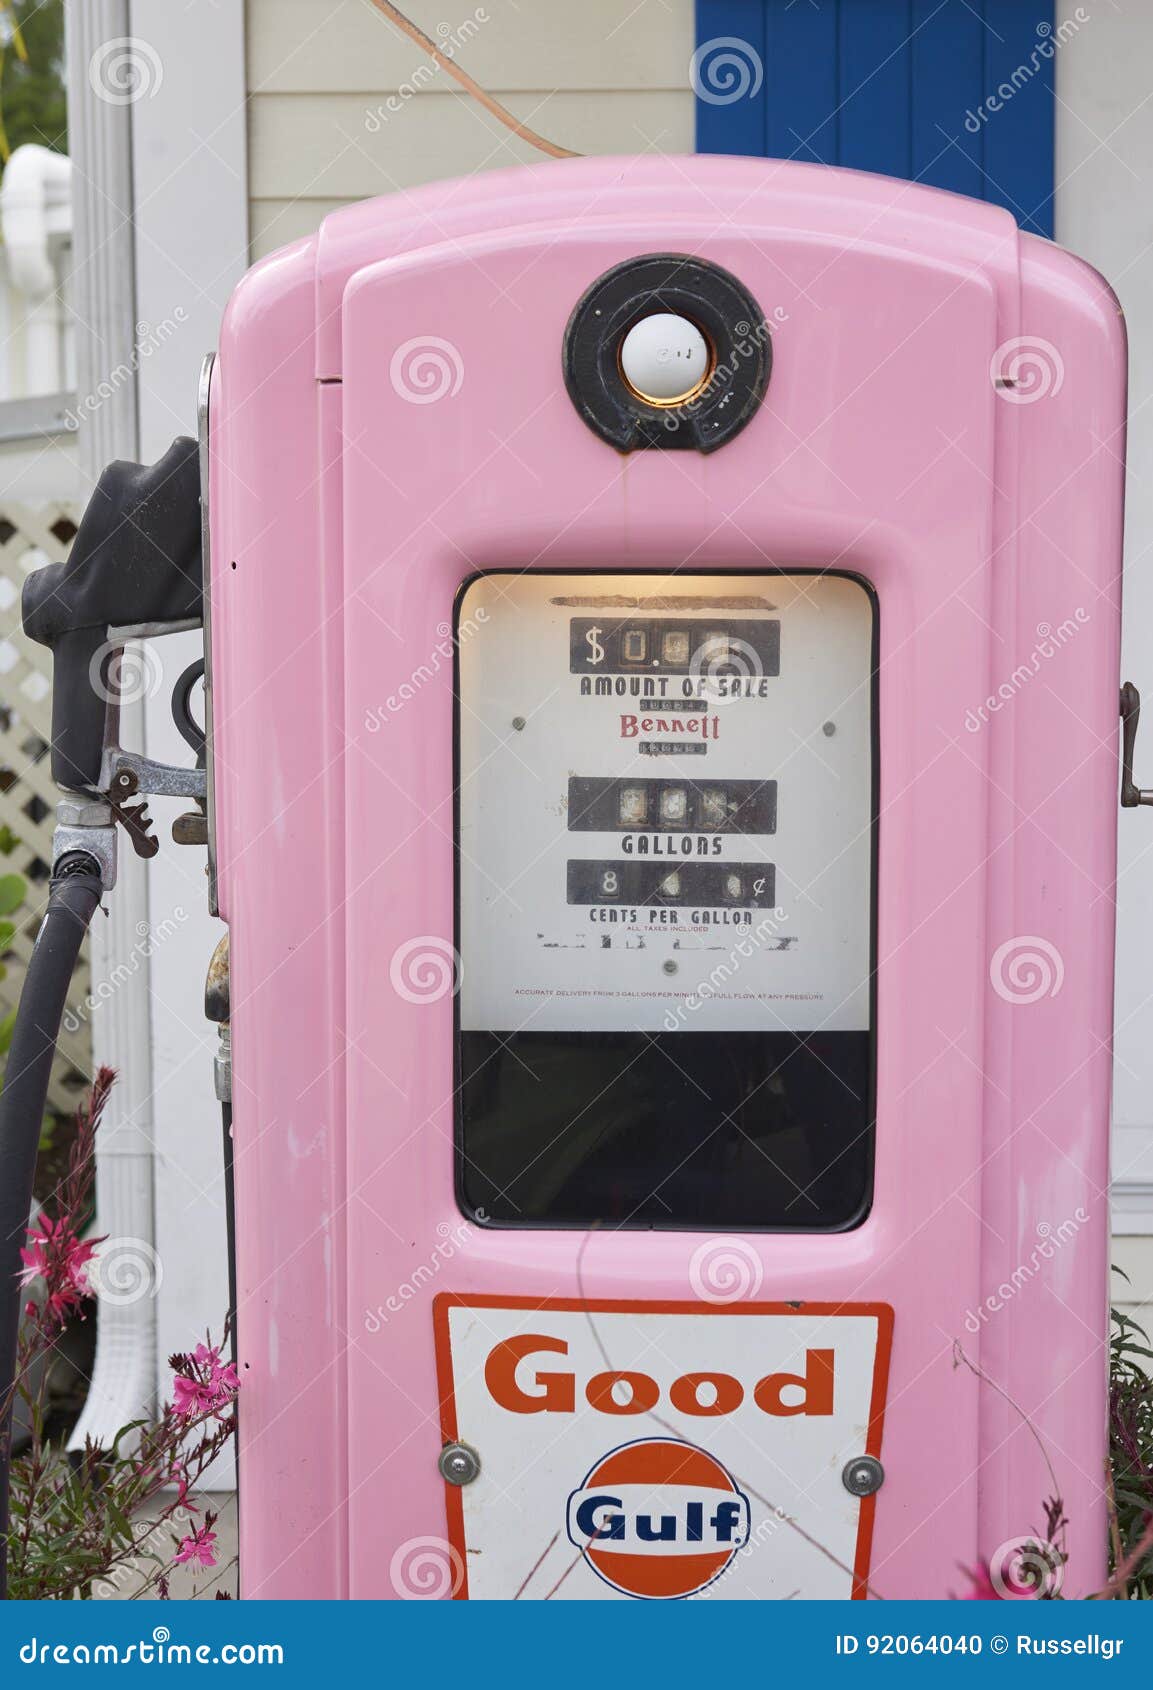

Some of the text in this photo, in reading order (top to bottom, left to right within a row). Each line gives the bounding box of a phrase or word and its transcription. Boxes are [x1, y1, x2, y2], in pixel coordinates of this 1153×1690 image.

[580, 676, 769, 698] AMOUNT OF SALE
[620, 714, 720, 739] Bennett
[621, 835, 722, 855] GALLONS
[589, 908, 753, 925] CENTS PER GALLON
[484, 1334, 835, 1416] Good
